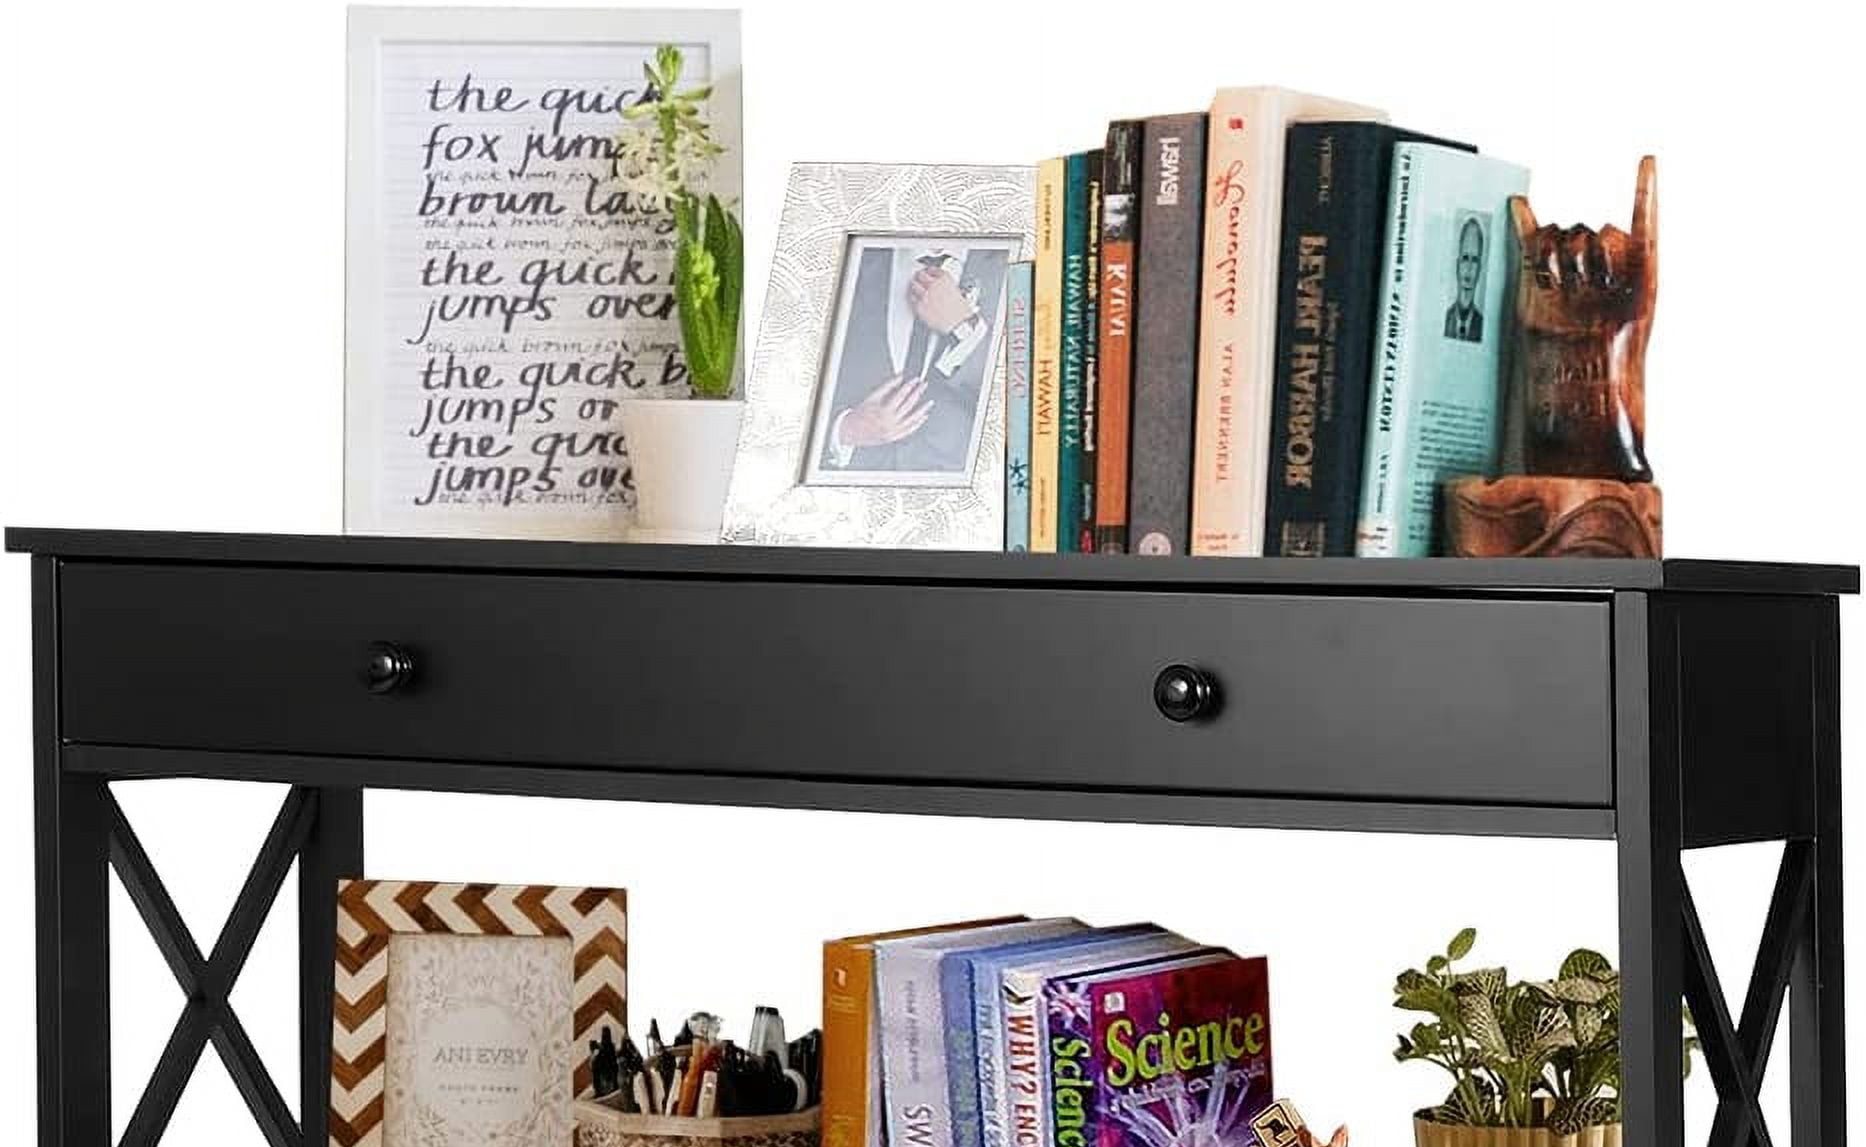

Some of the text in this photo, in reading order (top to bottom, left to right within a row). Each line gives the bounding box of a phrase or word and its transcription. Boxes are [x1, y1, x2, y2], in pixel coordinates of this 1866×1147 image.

[427, 73, 529, 113] the
[422, 123, 500, 169] fox
[421, 249, 658, 308] the quick
[406, 294, 557, 345] jumps
[420, 352, 504, 390] the
[518, 352, 646, 408] quick
[409, 398, 556, 438] jumps
[425, 431, 514, 459] the
[414, 460, 562, 506] jumps
[1005, 1014, 1038, 1099] WHY?
[1105, 1010, 1266, 1089] Science
